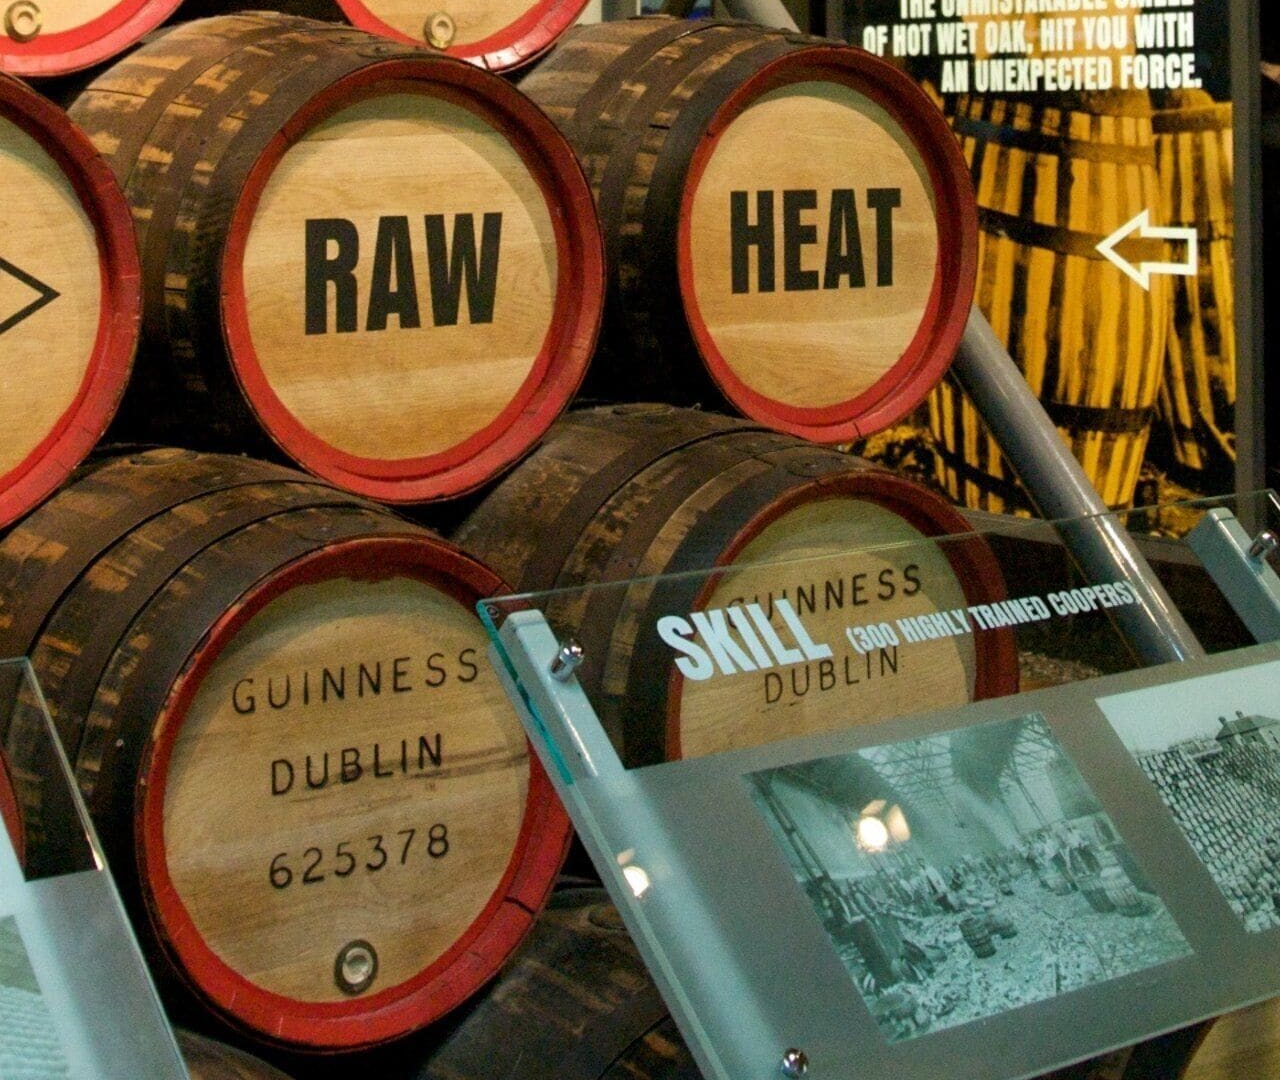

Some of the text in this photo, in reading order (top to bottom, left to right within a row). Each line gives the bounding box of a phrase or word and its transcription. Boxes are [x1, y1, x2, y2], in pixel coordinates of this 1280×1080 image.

[863, 11, 1194, 57] OF HOT WET OAK, HIT YOU WITH
[941, 52, 1203, 93] AN UNEXPECTED FORCE.
[304, 211, 503, 336] RAW
[730, 187, 902, 295] HEAT
[727, 564, 921, 628] NNESS
[656, 579, 1143, 681] SKILL (300 HIGHLY TRAINED COOPERS)
[231, 648, 480, 715] GUINNESS
[764, 646, 899, 704] DUBLIN
[271, 732, 444, 797] DUBLIN
[268, 822, 451, 889] 625378
